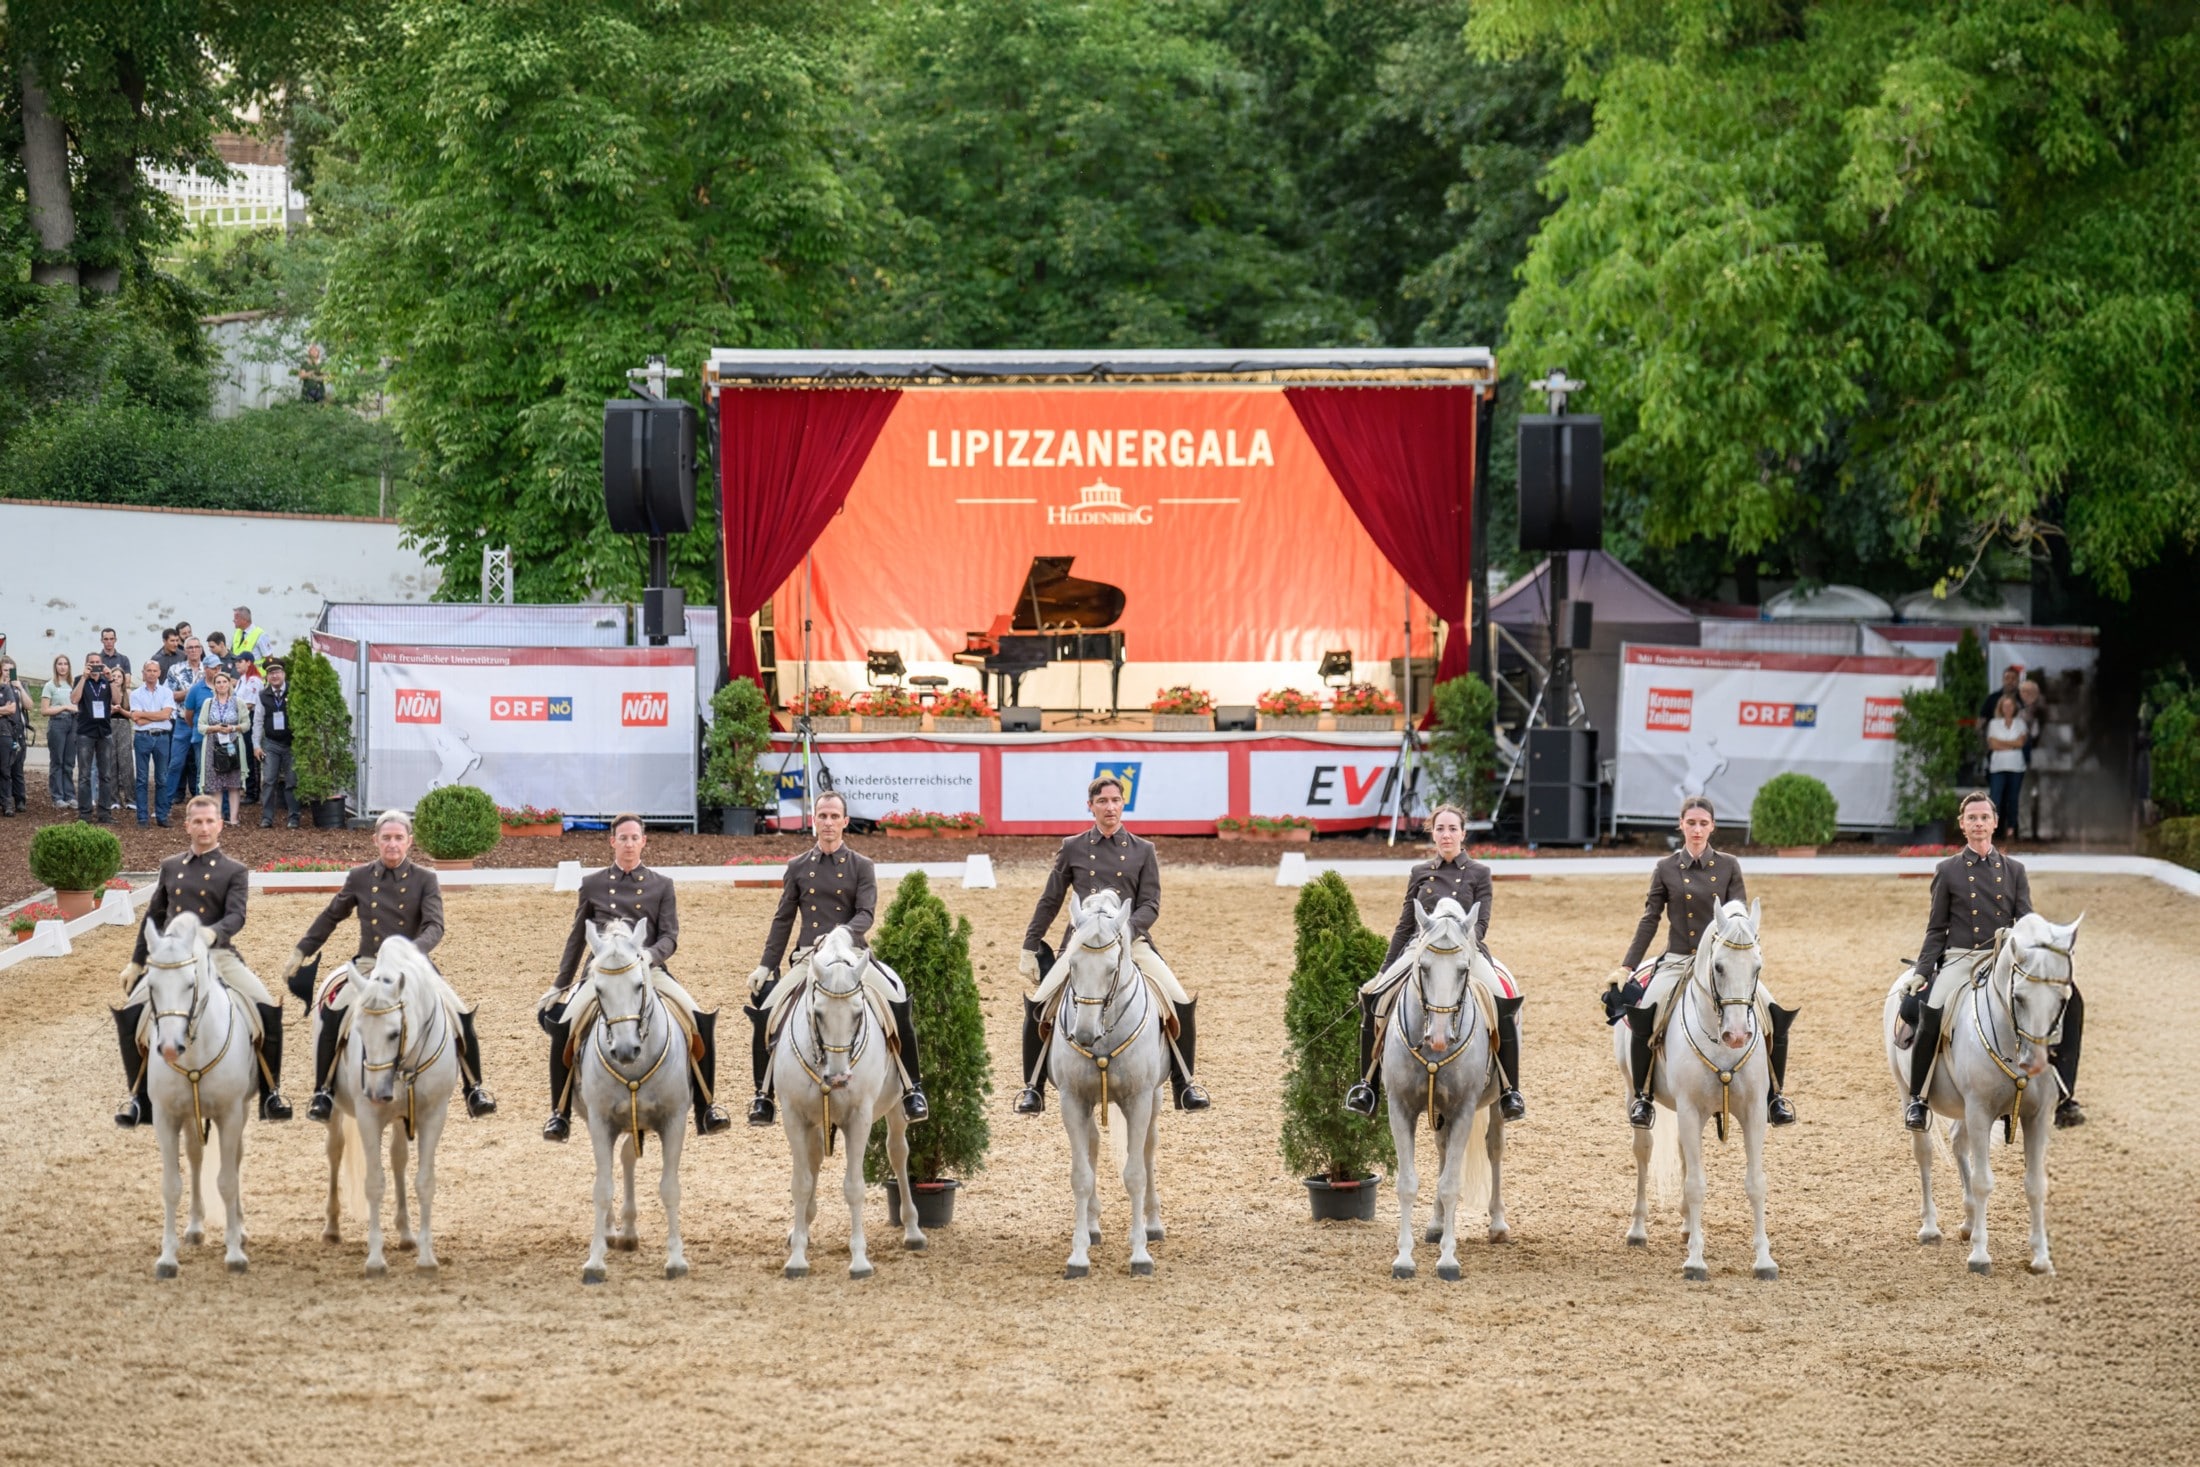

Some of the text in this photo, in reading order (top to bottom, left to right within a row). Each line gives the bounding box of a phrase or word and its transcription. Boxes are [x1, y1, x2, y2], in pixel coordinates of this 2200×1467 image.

[927, 429, 1274, 467] LIPIZZANERGALA
[383, 653, 510, 666] Mit freundlicher Unterstützung
[397, 691, 438, 717] NÖN
[494, 701, 571, 717] ORF NÖ
[624, 694, 666, 720] NÖN
[1650, 693, 1691, 709] Kronen
[1648, 709, 1690, 728] Zeitung
[1742, 704, 1791, 723] ORF
[844, 774, 973, 787] Niederösterreichische
